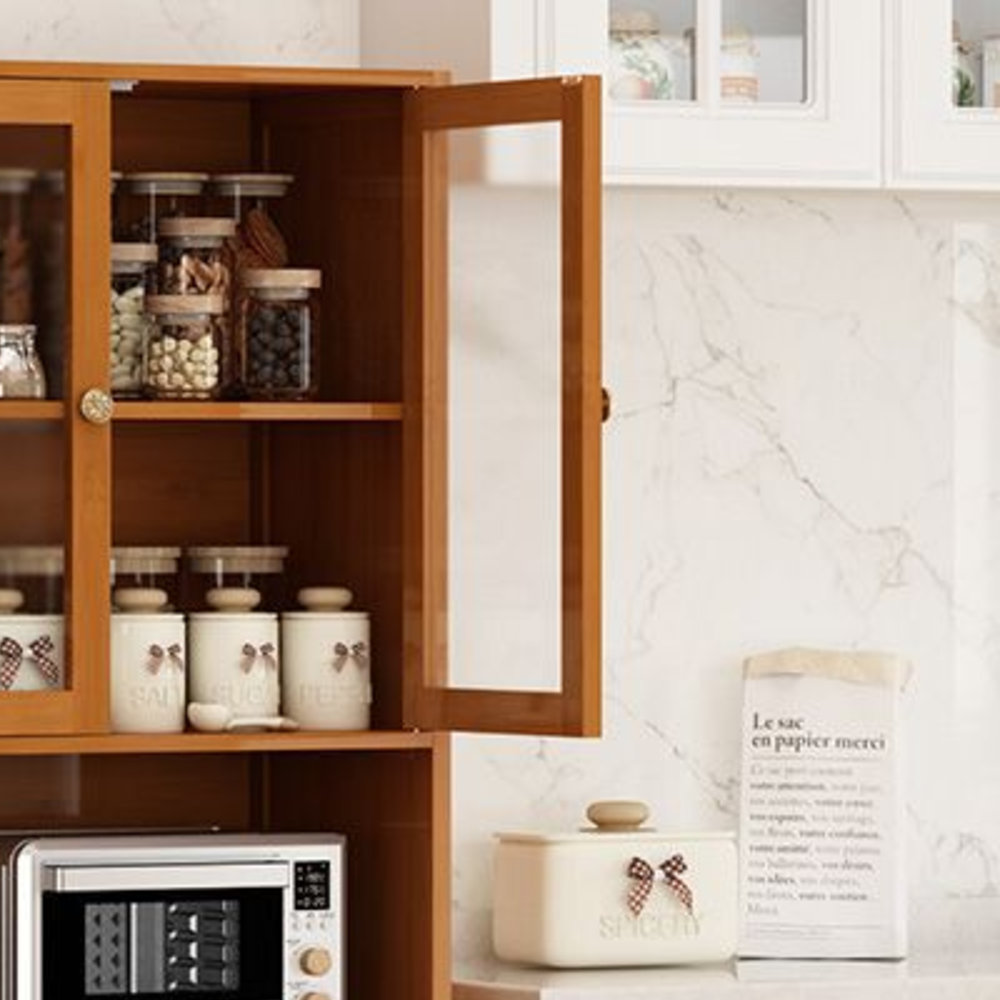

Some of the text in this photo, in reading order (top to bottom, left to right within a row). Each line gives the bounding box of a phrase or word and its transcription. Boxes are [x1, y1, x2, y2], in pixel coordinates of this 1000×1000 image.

[754, 712, 805, 730] Le sac
[752, 731, 887, 752] en papier merci
